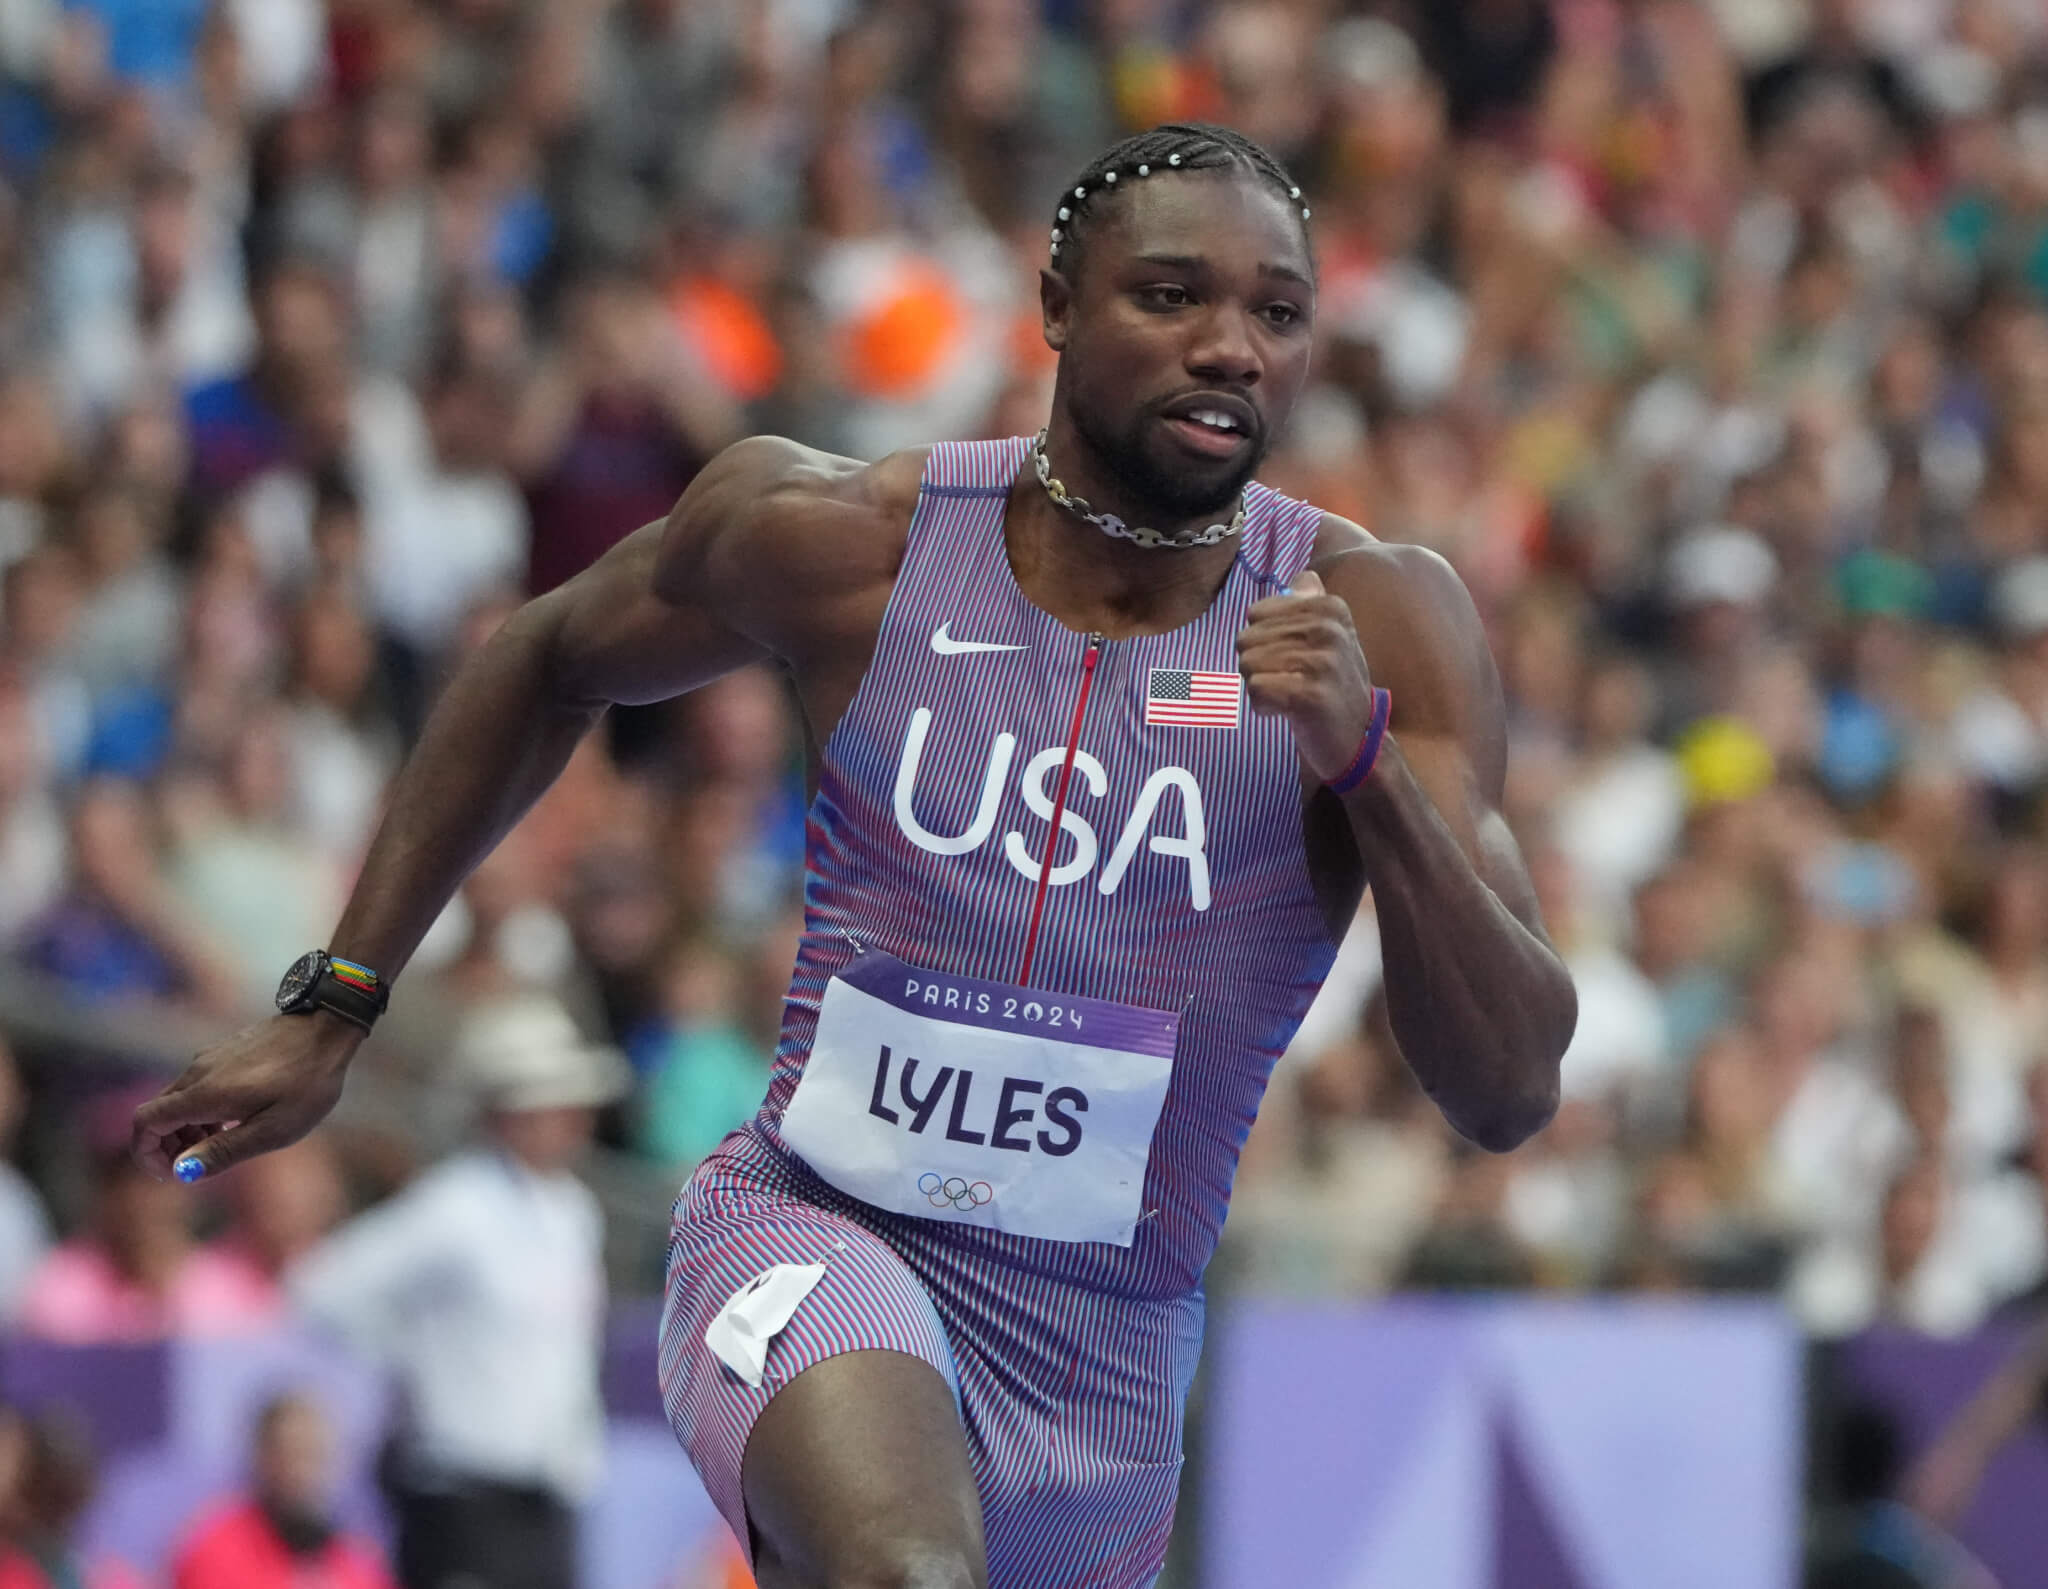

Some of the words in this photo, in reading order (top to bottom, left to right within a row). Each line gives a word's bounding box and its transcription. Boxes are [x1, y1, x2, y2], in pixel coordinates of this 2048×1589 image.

[894, 706, 1211, 912] USA
[1002, 998, 1084, 1031] 2024
[868, 1044, 1090, 1157] LYLES
